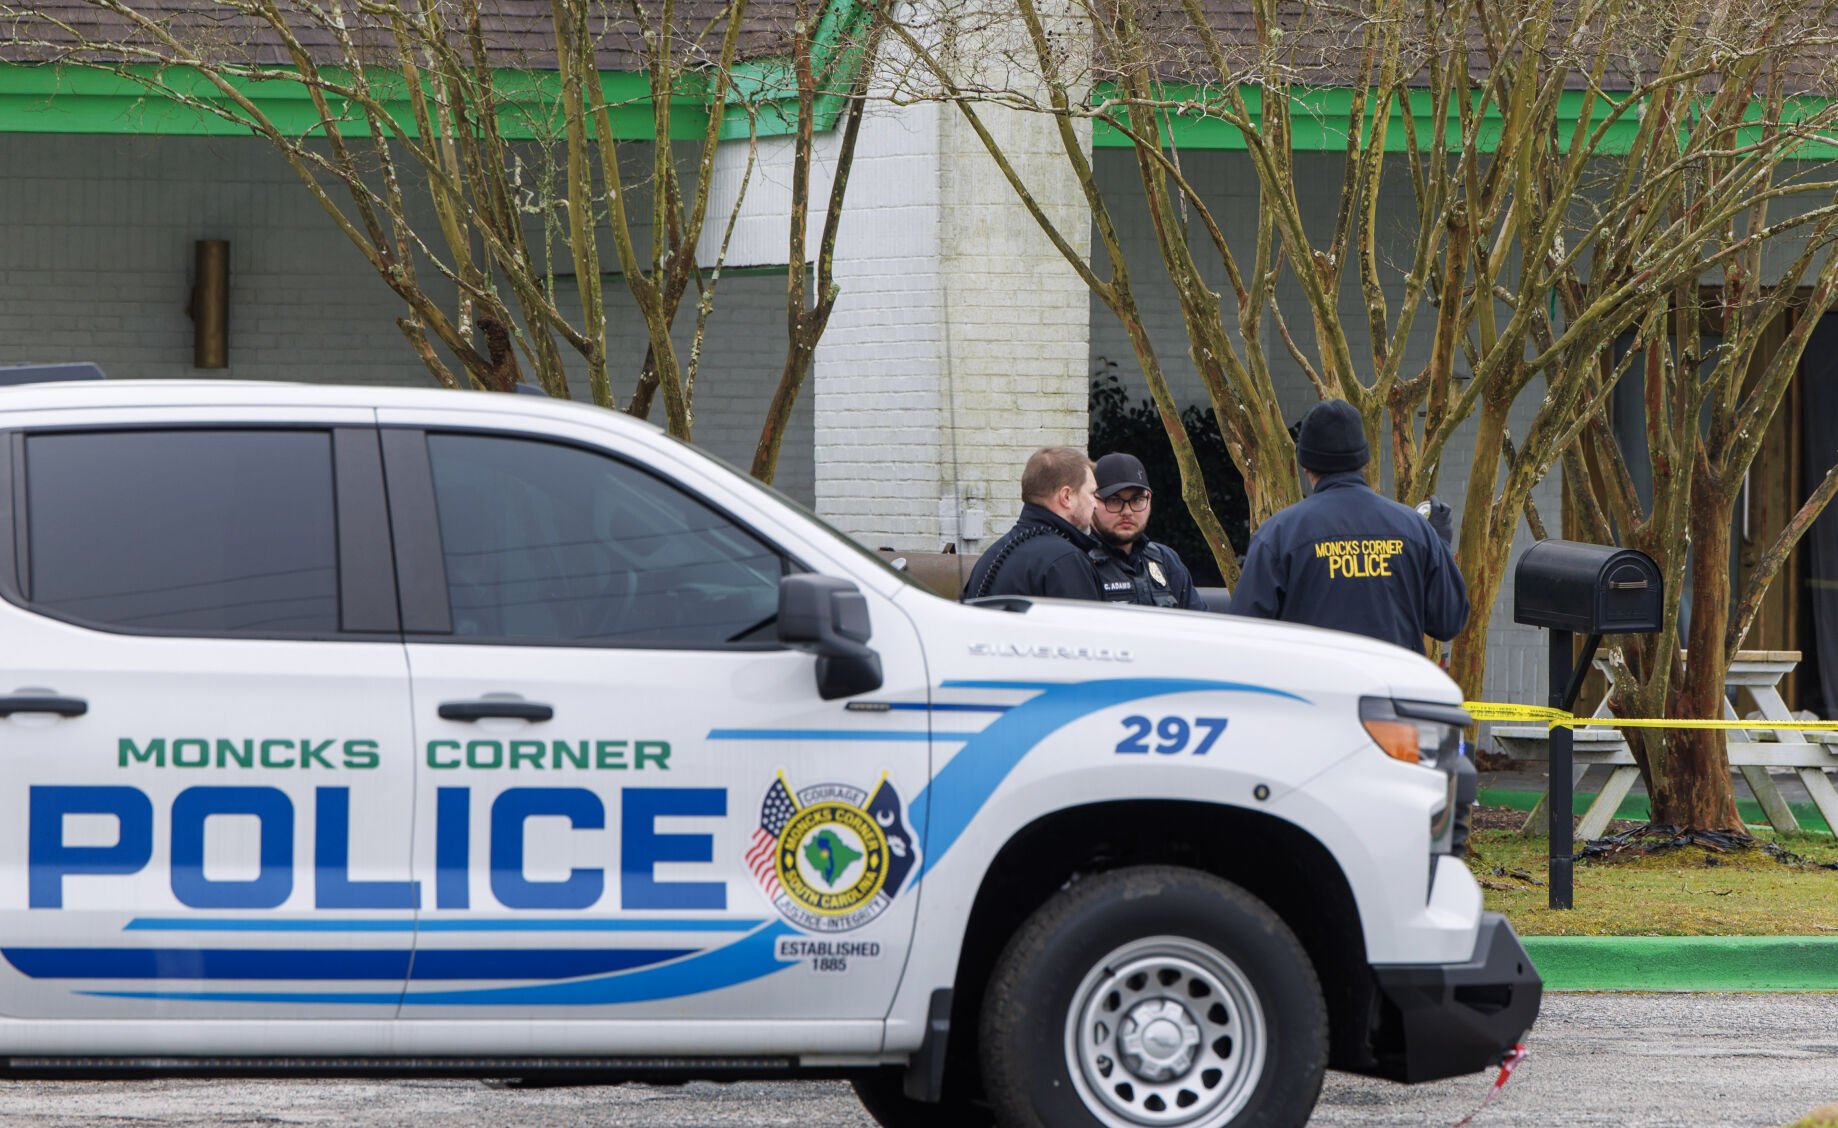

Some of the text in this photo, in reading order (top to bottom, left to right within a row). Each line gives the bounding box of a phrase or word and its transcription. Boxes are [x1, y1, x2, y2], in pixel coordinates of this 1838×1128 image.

[1315, 540, 1403, 558] MONCKS CORNER
[1329, 554, 1392, 579] POLICE
[968, 642, 1134, 663] SILVERADO
[1115, 715, 1229, 756] 297
[117, 738, 672, 771] MONCKS CORNER
[803, 788, 860, 803] COURAGE
[784, 808, 879, 851] MONCKS CORNER
[28, 785, 728, 910] POLICE
[784, 870, 878, 910] SOUTH CAROLINA
[780, 942, 880, 957] ESTABLISHED
[812, 958, 847, 971] 1885
